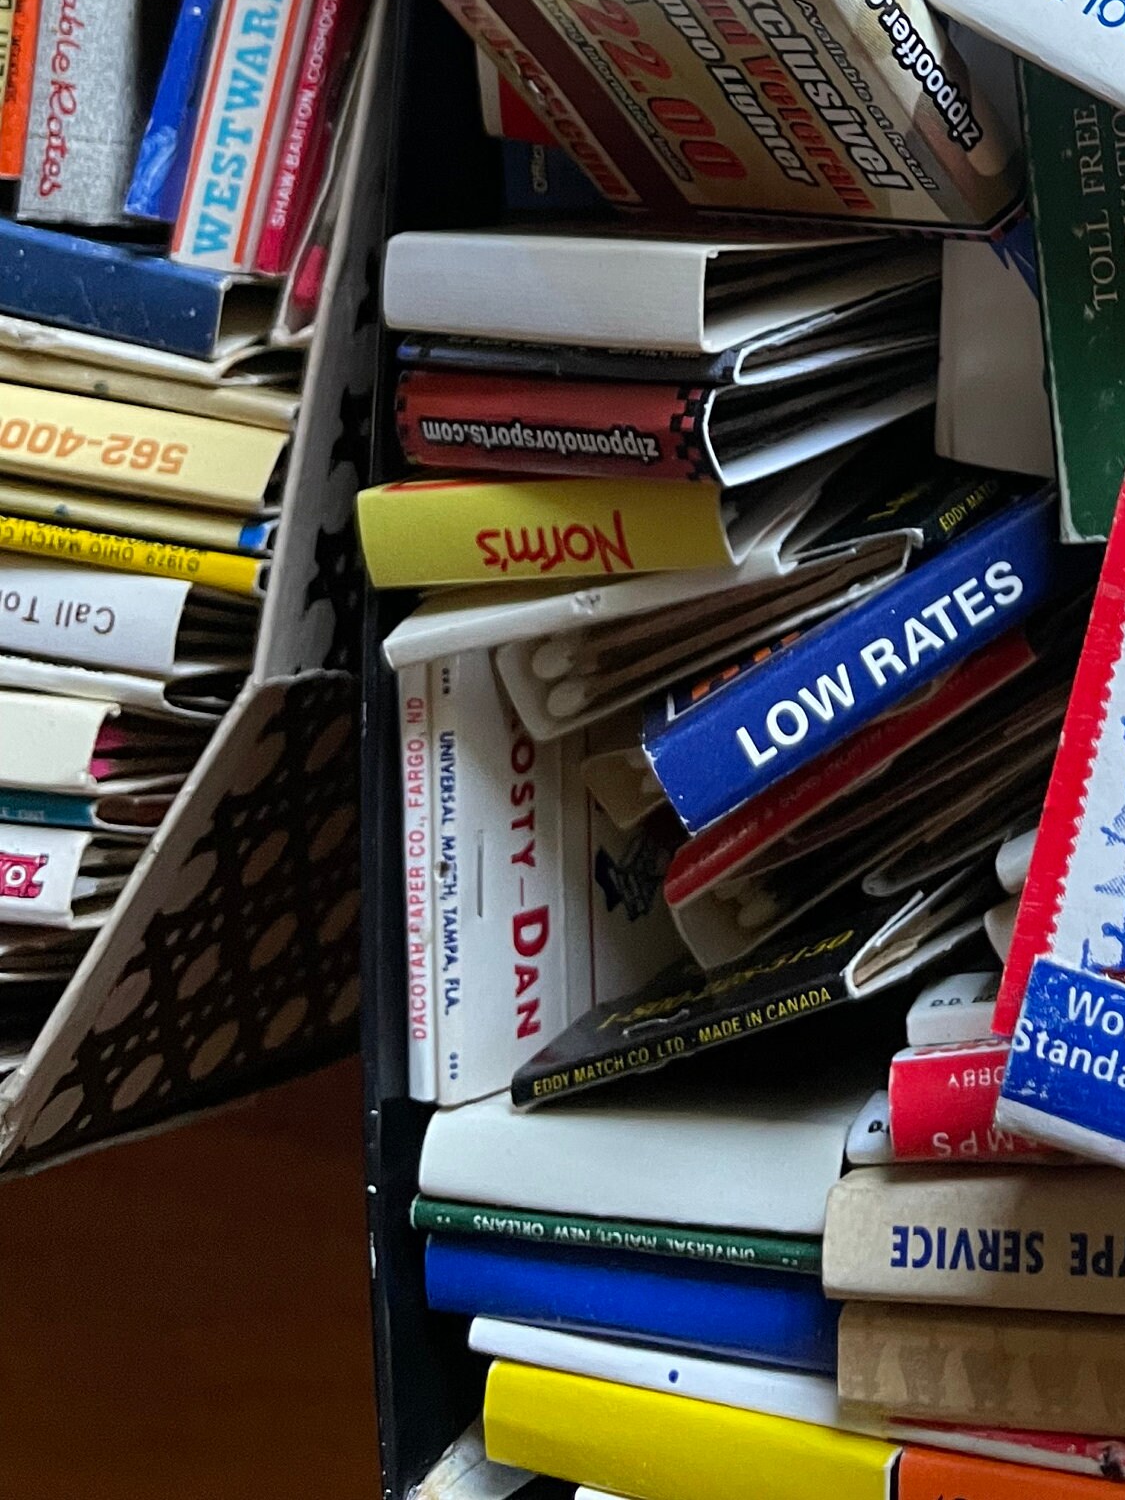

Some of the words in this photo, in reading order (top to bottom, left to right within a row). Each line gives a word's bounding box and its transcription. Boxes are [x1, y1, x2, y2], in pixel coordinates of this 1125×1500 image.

[573, 44, 663, 137] Information
[648, 136, 700, 184] Inside
[699, 64, 829, 188] Lighter
[727, 55, 887, 207] Veteran
[780, 0, 889, 103] Available
[861, 105, 895, 130] at
[879, 133, 941, 192] Retail
[35, 80, 81, 205] Rates
[1071, 102, 1107, 195] FREE
[1082, 208, 1120, 311] TOLL
[418, 403, 661, 468] zippomotorsports.com
[88, 538, 135, 565] OHIO
[472, 507, 634, 583] Norm's
[936, 501, 972, 533] EDDY
[54, 598, 117, 635] Call
[730, 660, 868, 769] LOW
[851, 553, 1033, 690] RATES
[436, 730, 459, 825] UNIVERSAL
[406, 864, 426, 933] PAPER
[439, 905, 461, 972] TAMPA,
[529, 1069, 573, 1097] EDDY
[570, 1053, 628, 1085] MATCH
[694, 1014, 744, 1045] MADE
[742, 1007, 764, 1029] IN
[763, 984, 835, 1023] CANADA
[471, 1211, 547, 1239] ORLEANS
[663, 1234, 756, 1263] UNIVERSAL
[888, 1223, 1045, 1275] SERVICE
